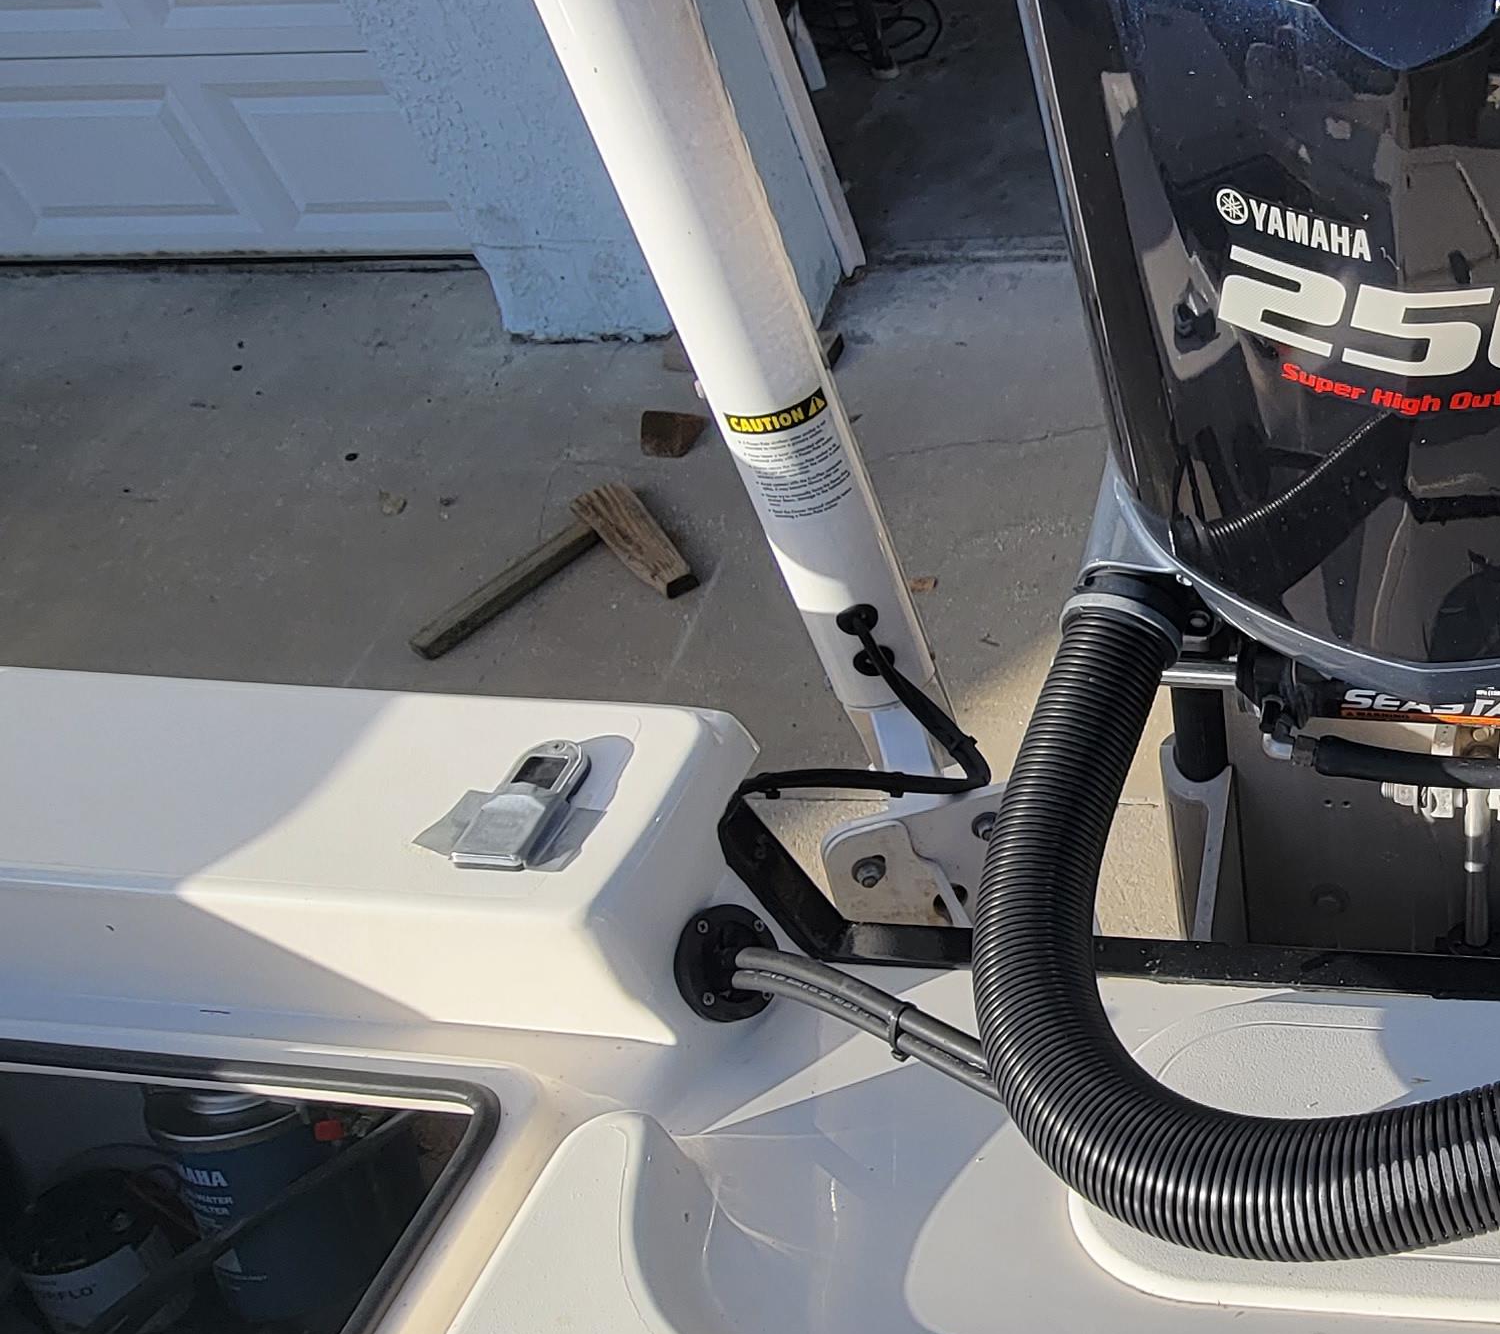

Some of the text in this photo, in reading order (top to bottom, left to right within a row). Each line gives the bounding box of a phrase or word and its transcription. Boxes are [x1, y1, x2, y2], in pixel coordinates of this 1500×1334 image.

[1249, 199, 1372, 262] YAMAHA
[1282, 362, 1366, 400] Super
[1371, 387, 1441, 416] High
[730, 406, 805, 433] CAUTION
